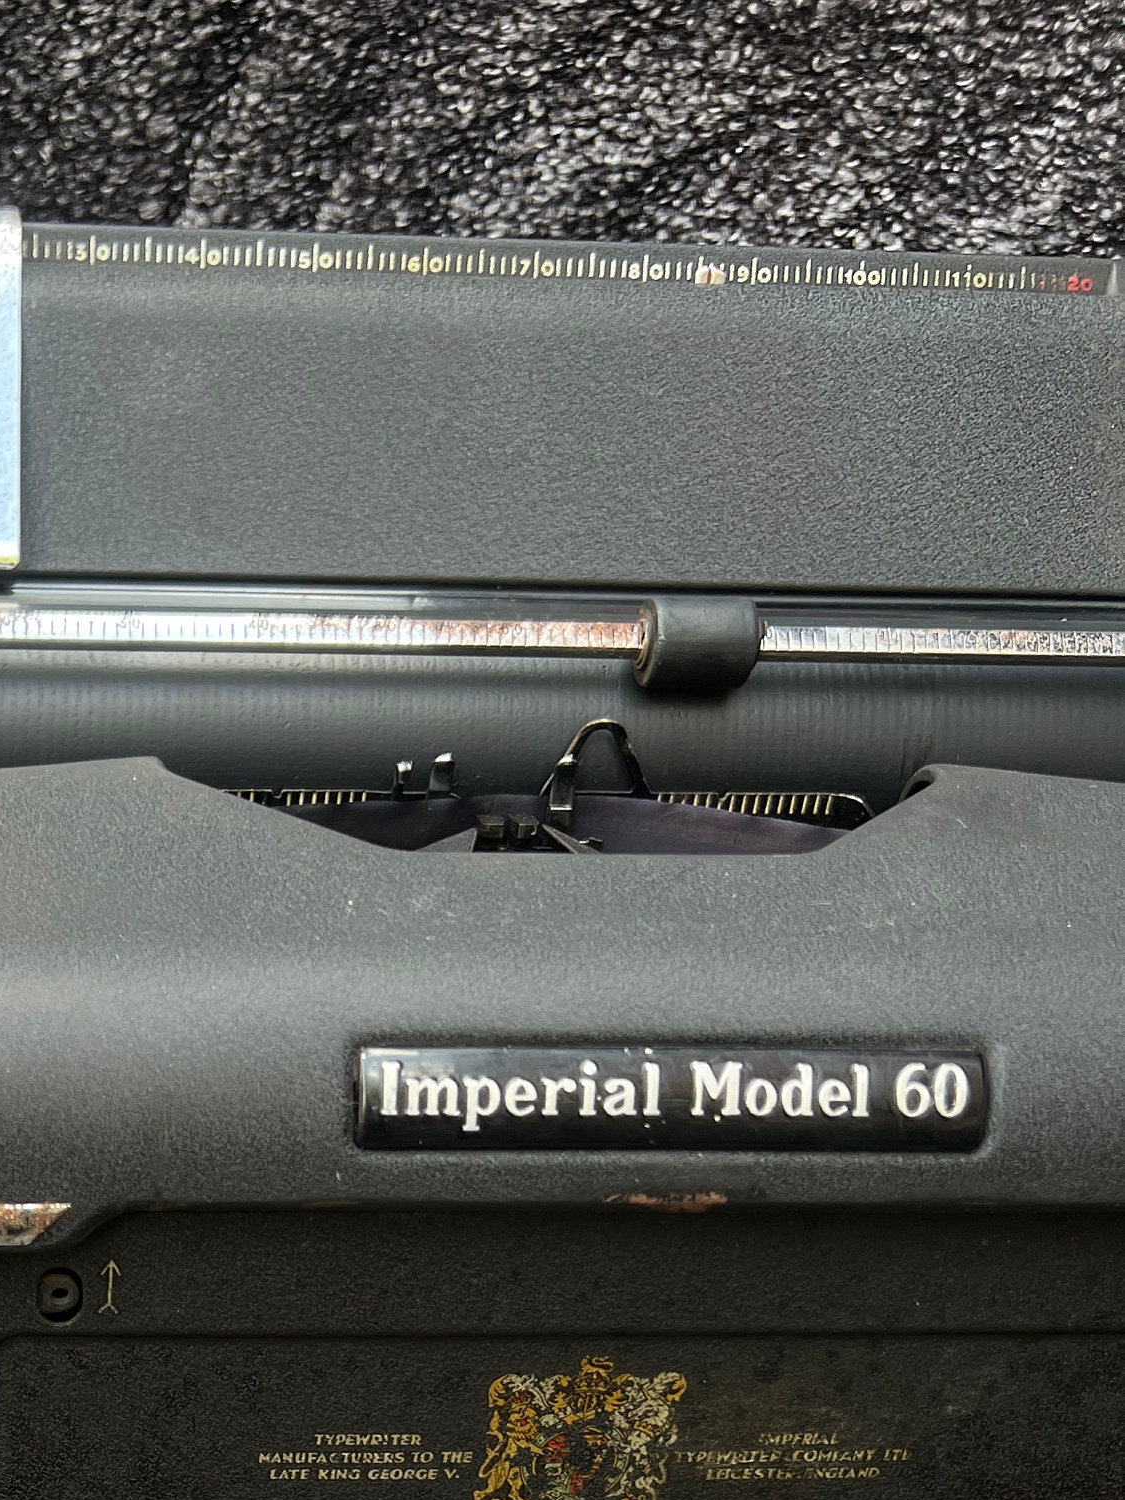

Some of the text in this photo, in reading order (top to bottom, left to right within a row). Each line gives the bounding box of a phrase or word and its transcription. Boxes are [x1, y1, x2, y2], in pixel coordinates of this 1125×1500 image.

[379, 1059, 969, 1131] Imperial Model 60
[314, 1434, 422, 1446] TYPEWRITER
[258, 1451, 474, 1464] MANUFACTURERS TO THE
[270, 1469, 460, 1480] LATE KING GEORGE V.
